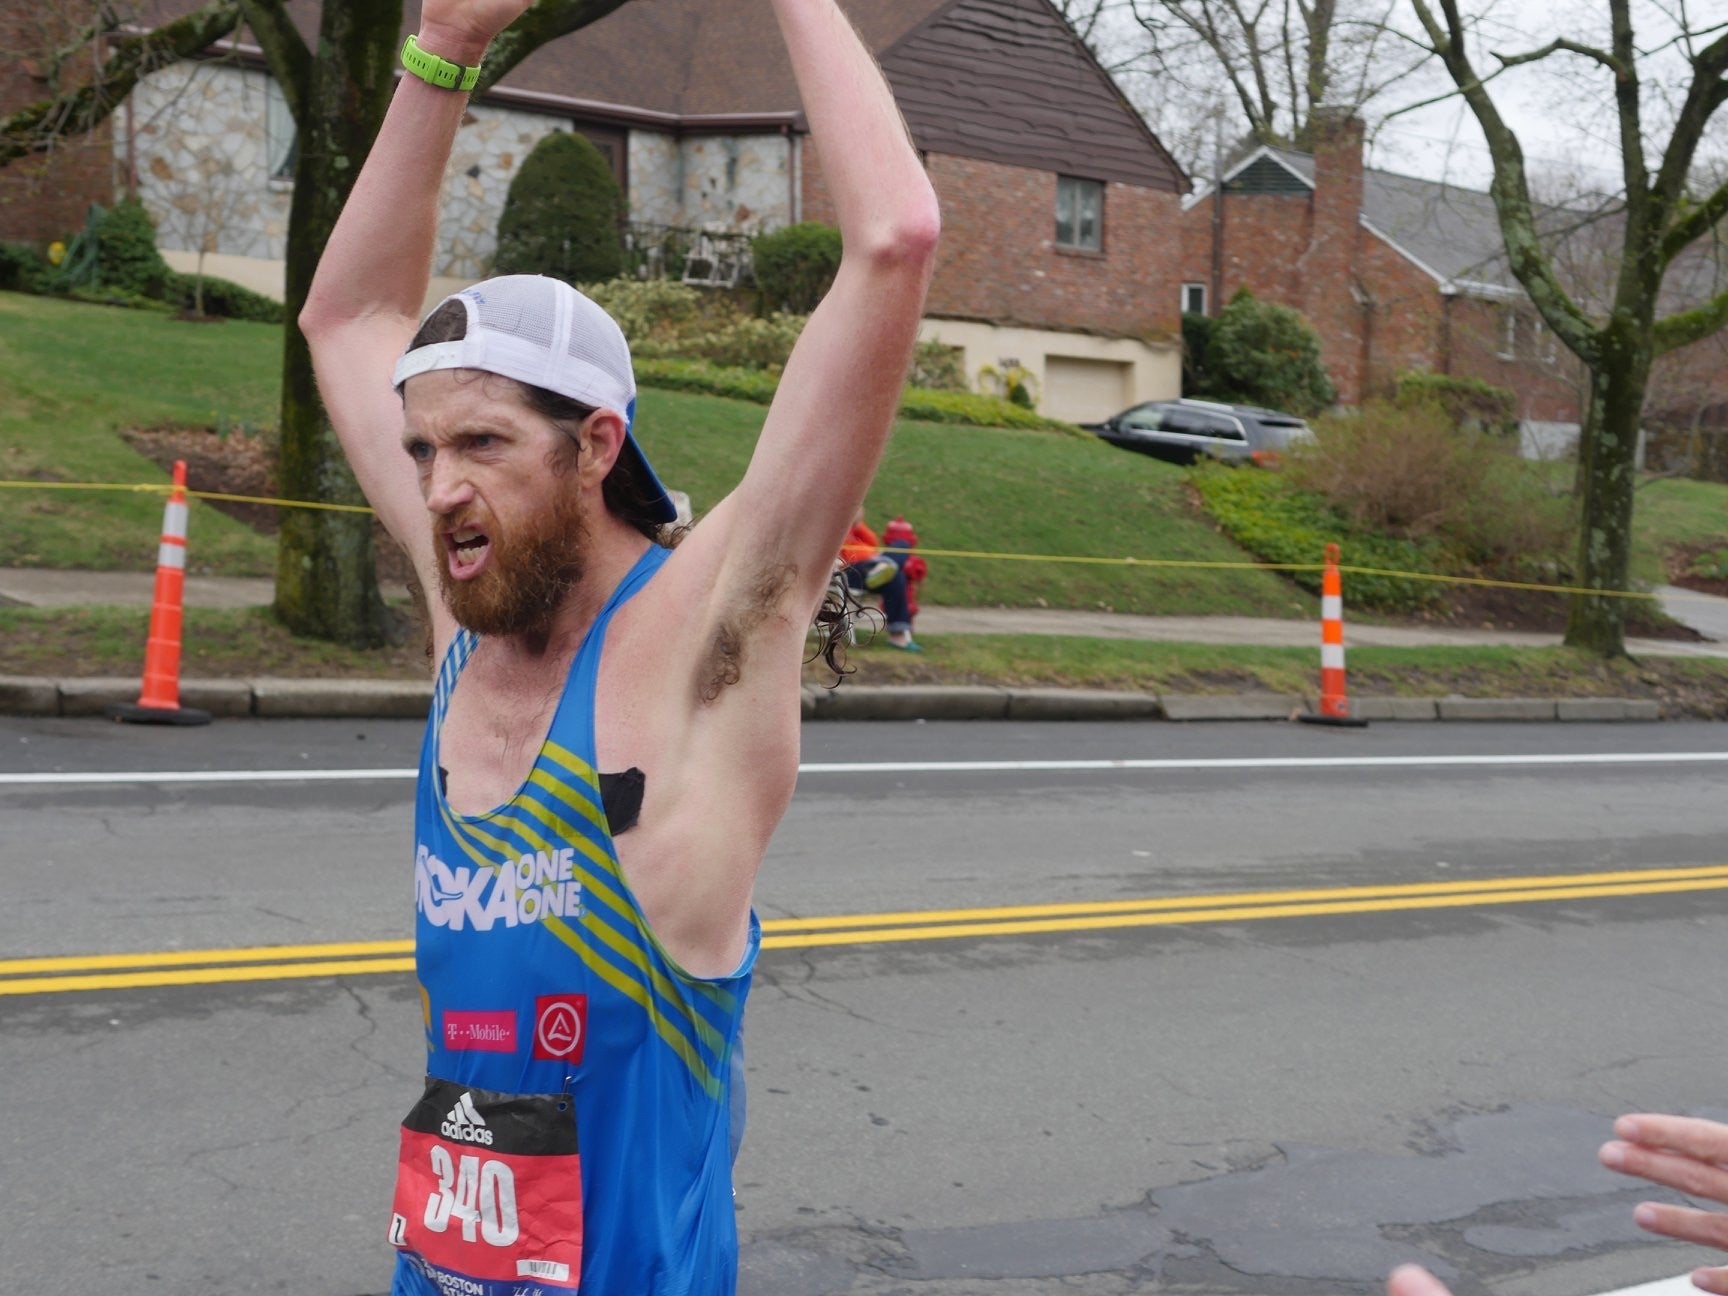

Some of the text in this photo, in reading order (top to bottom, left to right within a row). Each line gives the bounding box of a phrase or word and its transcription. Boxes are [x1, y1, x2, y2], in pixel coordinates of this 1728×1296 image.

[516, 848, 574, 889] ONE
[518, 882, 582, 924] ONE
[441, 1121, 494, 1146] adidas
[423, 1145, 520, 1247] 340
[437, 1271, 484, 1296] BOSTON
